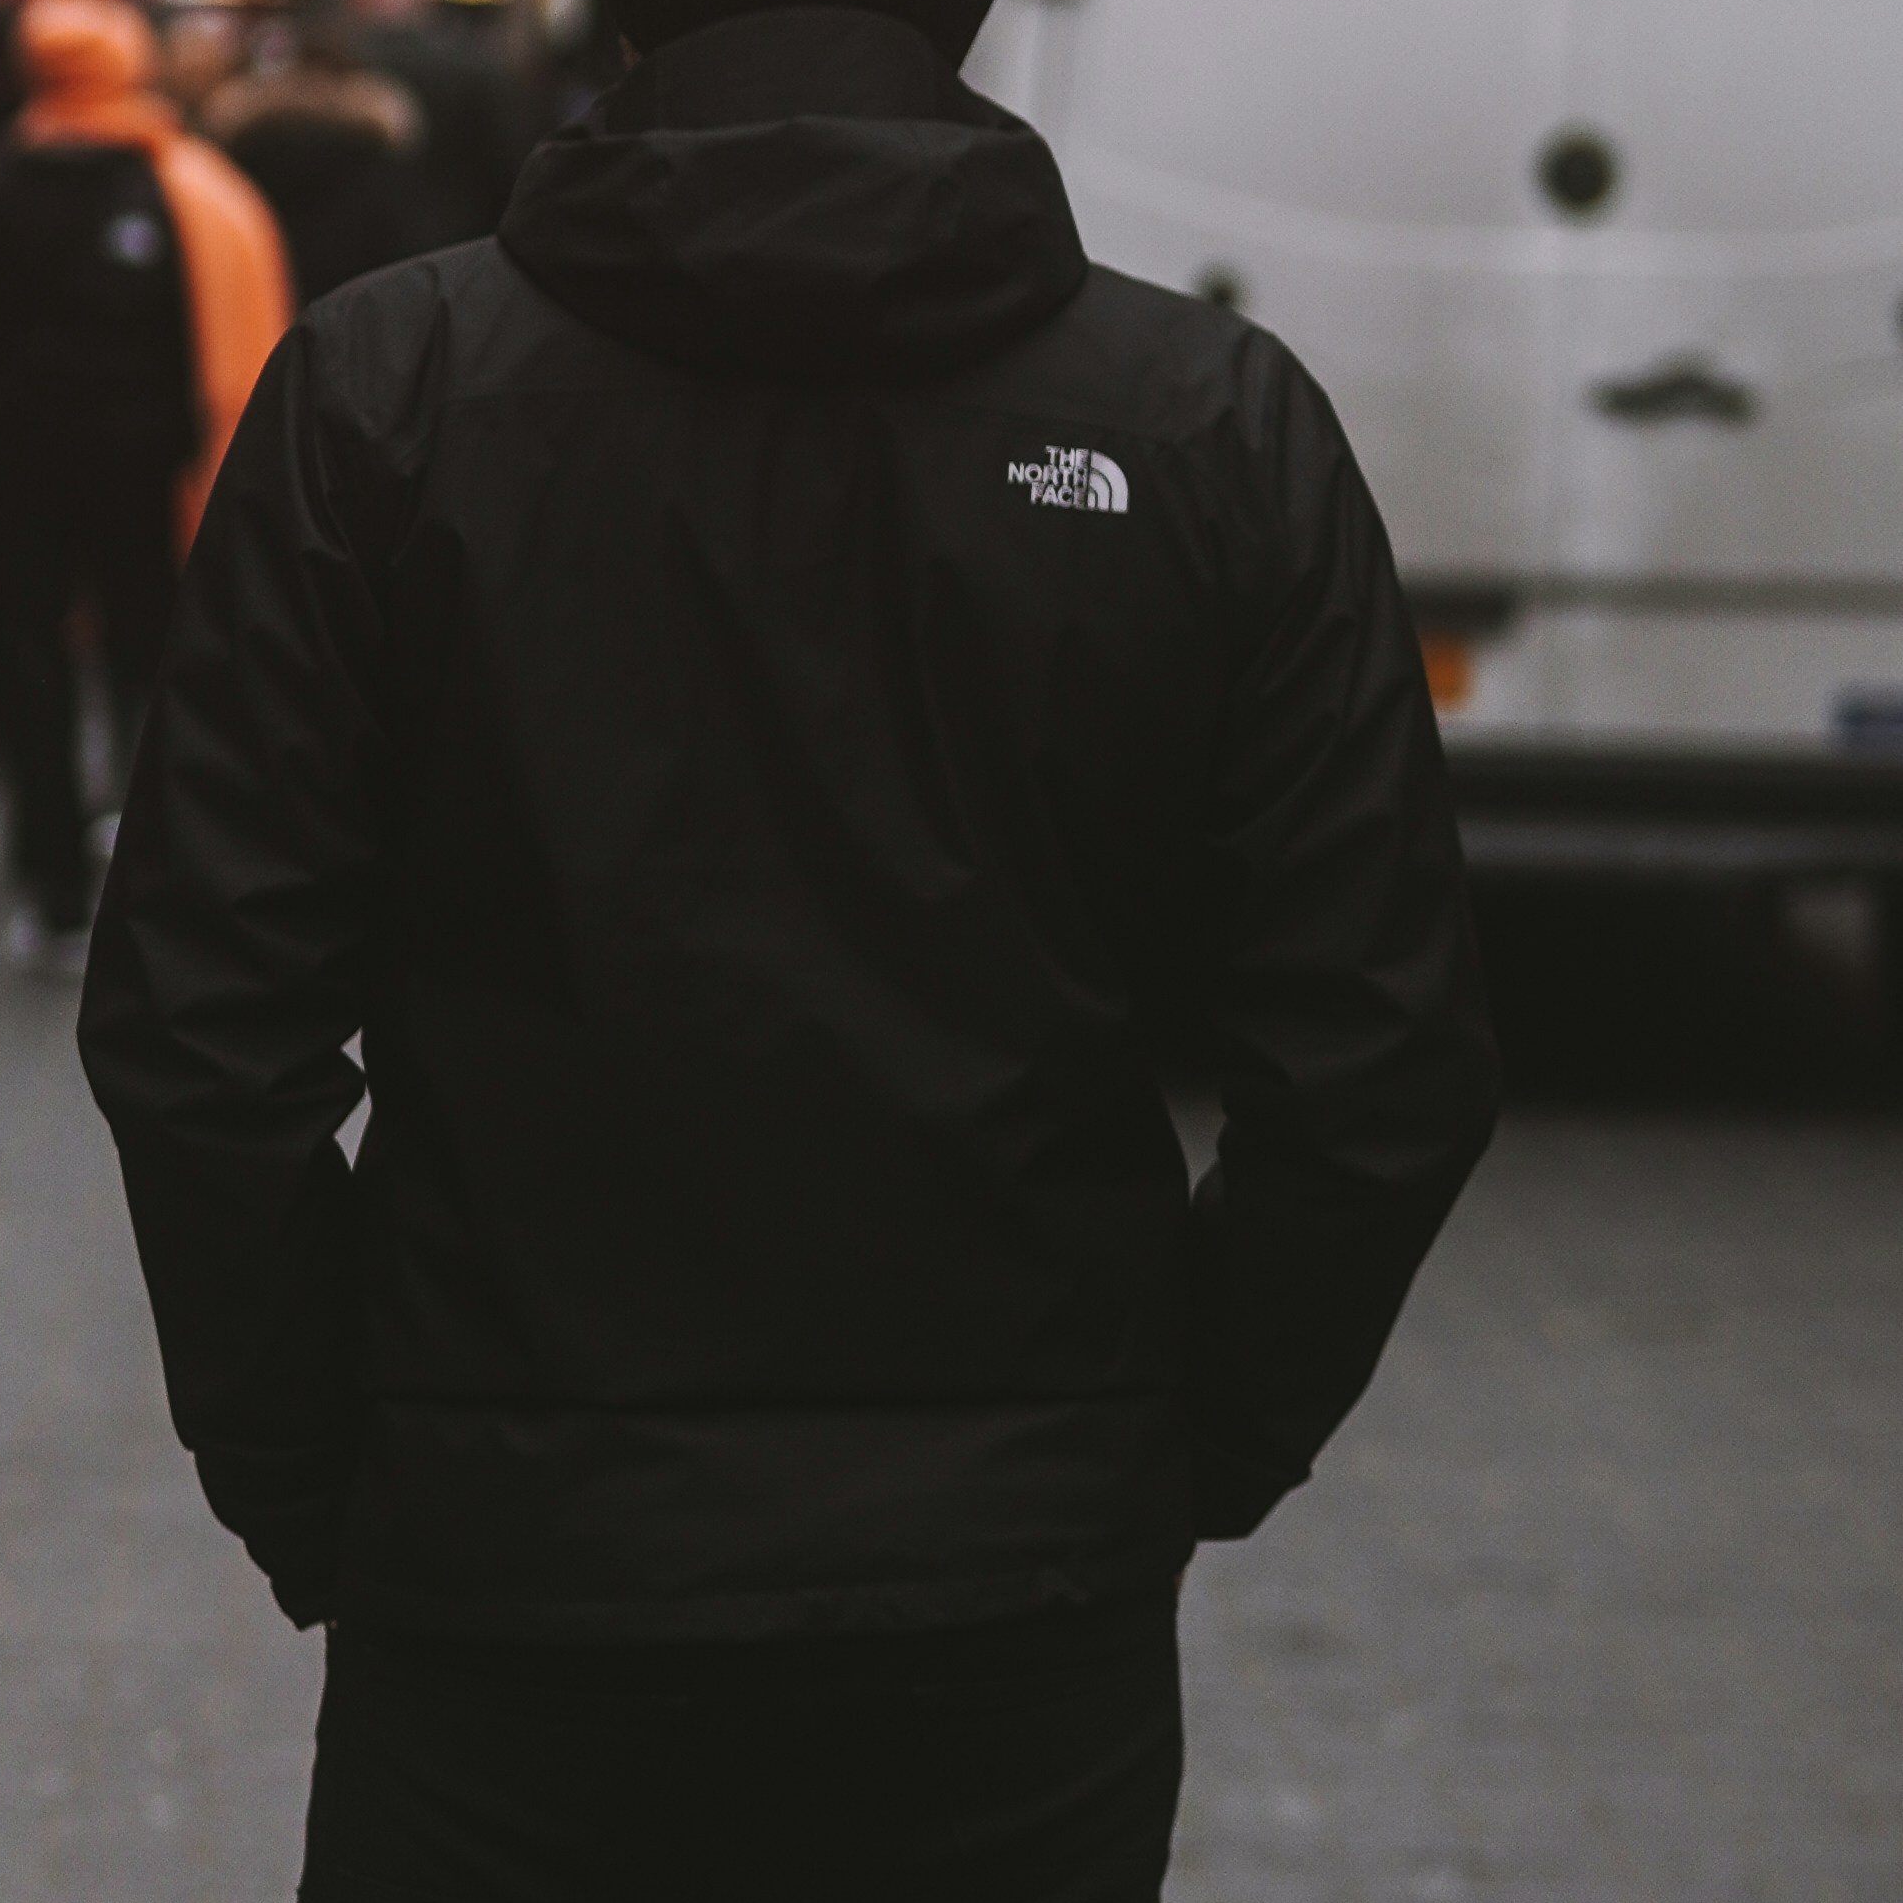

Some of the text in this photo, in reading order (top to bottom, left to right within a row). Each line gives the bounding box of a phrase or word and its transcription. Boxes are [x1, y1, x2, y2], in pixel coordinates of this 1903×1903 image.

[1046, 445, 1089, 466] THE
[1008, 461, 1088, 488] NORTH
[1031, 481, 1088, 510] FACE
